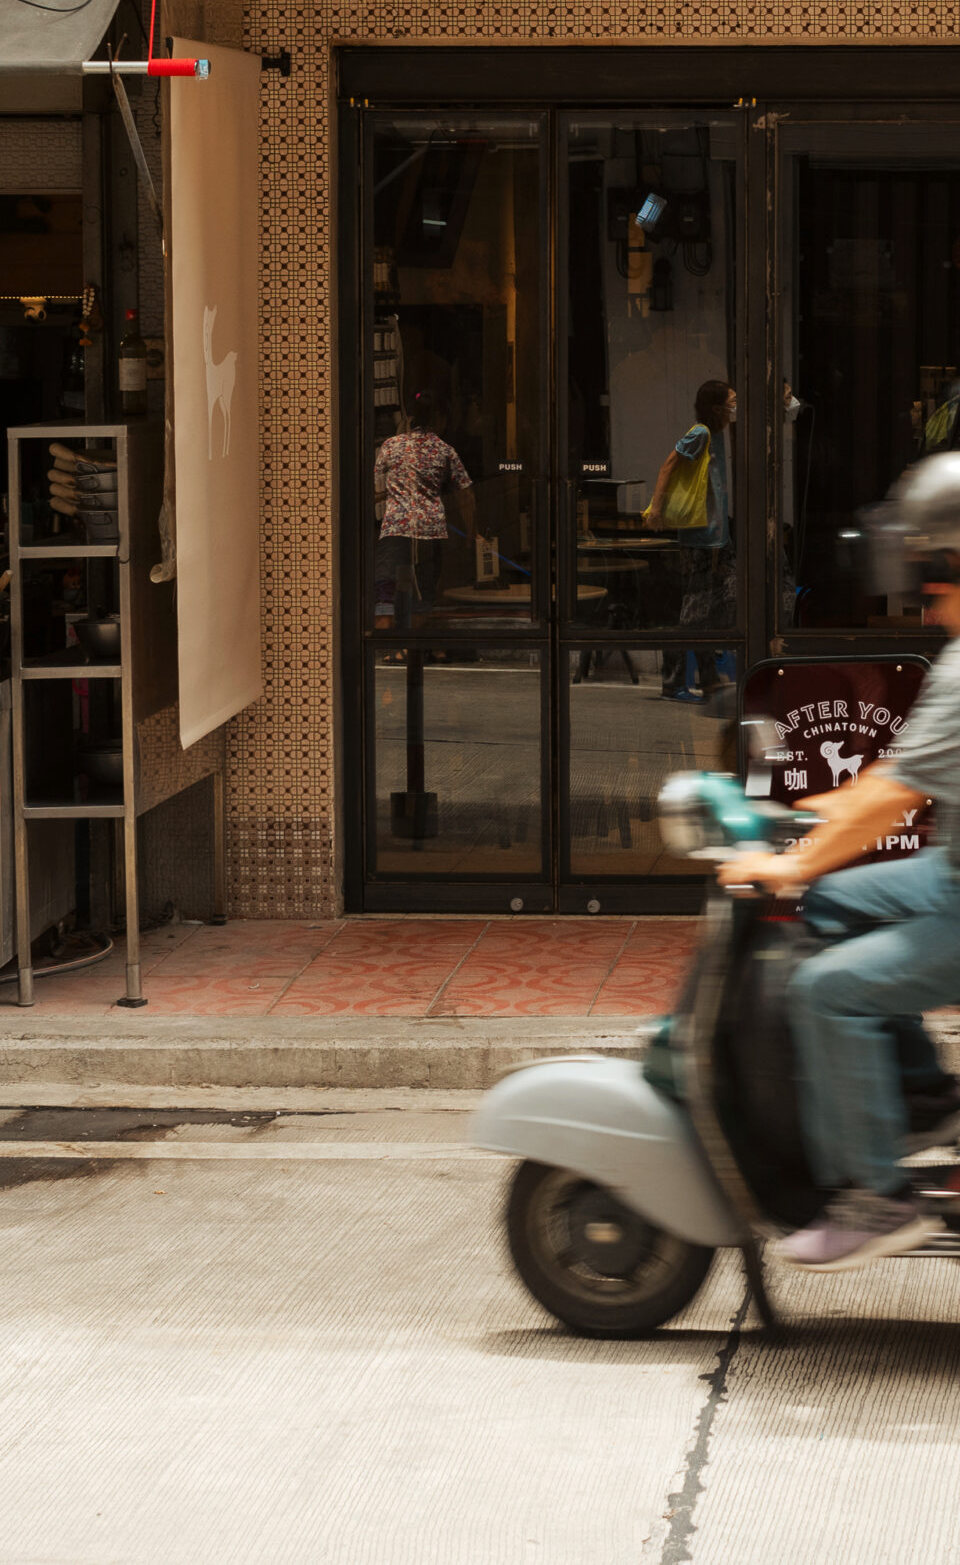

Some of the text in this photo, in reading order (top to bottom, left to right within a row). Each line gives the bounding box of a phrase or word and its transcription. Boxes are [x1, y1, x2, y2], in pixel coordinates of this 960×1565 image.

[499, 463, 523, 471] PUSH
[582, 464, 607, 472] PUSH
[774, 700, 909, 740] AFTER YOU
[803, 722, 878, 739] CHINATOWN
[777, 748, 906, 762] EST. 200
